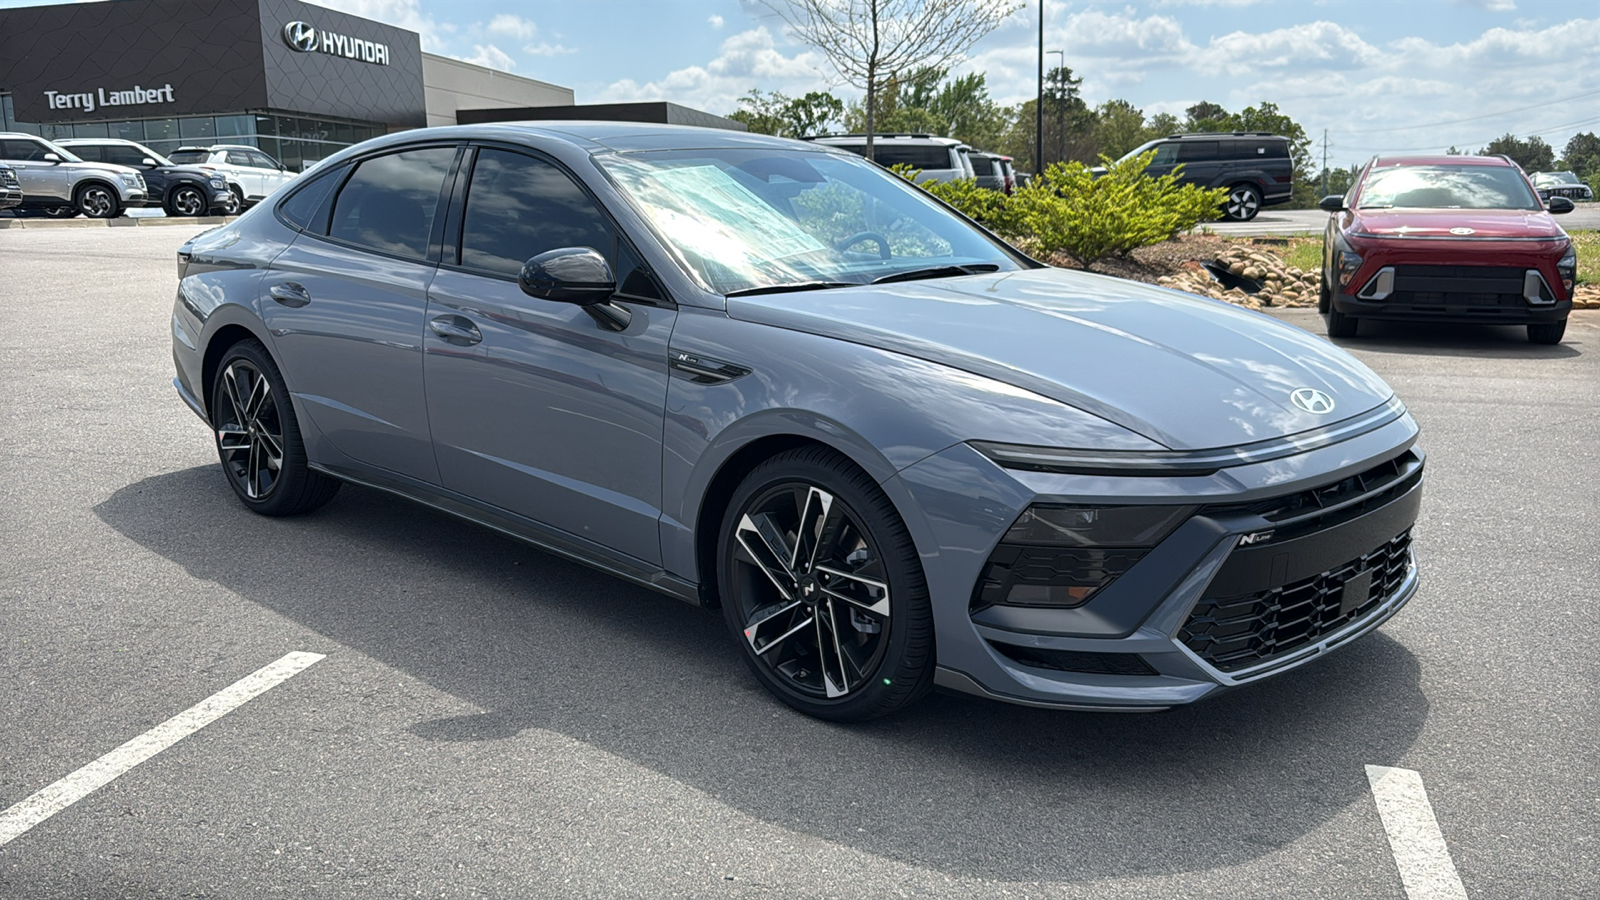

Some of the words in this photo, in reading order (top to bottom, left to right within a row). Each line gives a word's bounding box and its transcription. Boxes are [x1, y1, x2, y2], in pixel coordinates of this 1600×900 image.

[322, 30, 389, 65] HYUNDAI
[43, 90, 95, 112] Terry
[98, 84, 175, 106] Lambert
[1239, 533, 1256, 545] N
